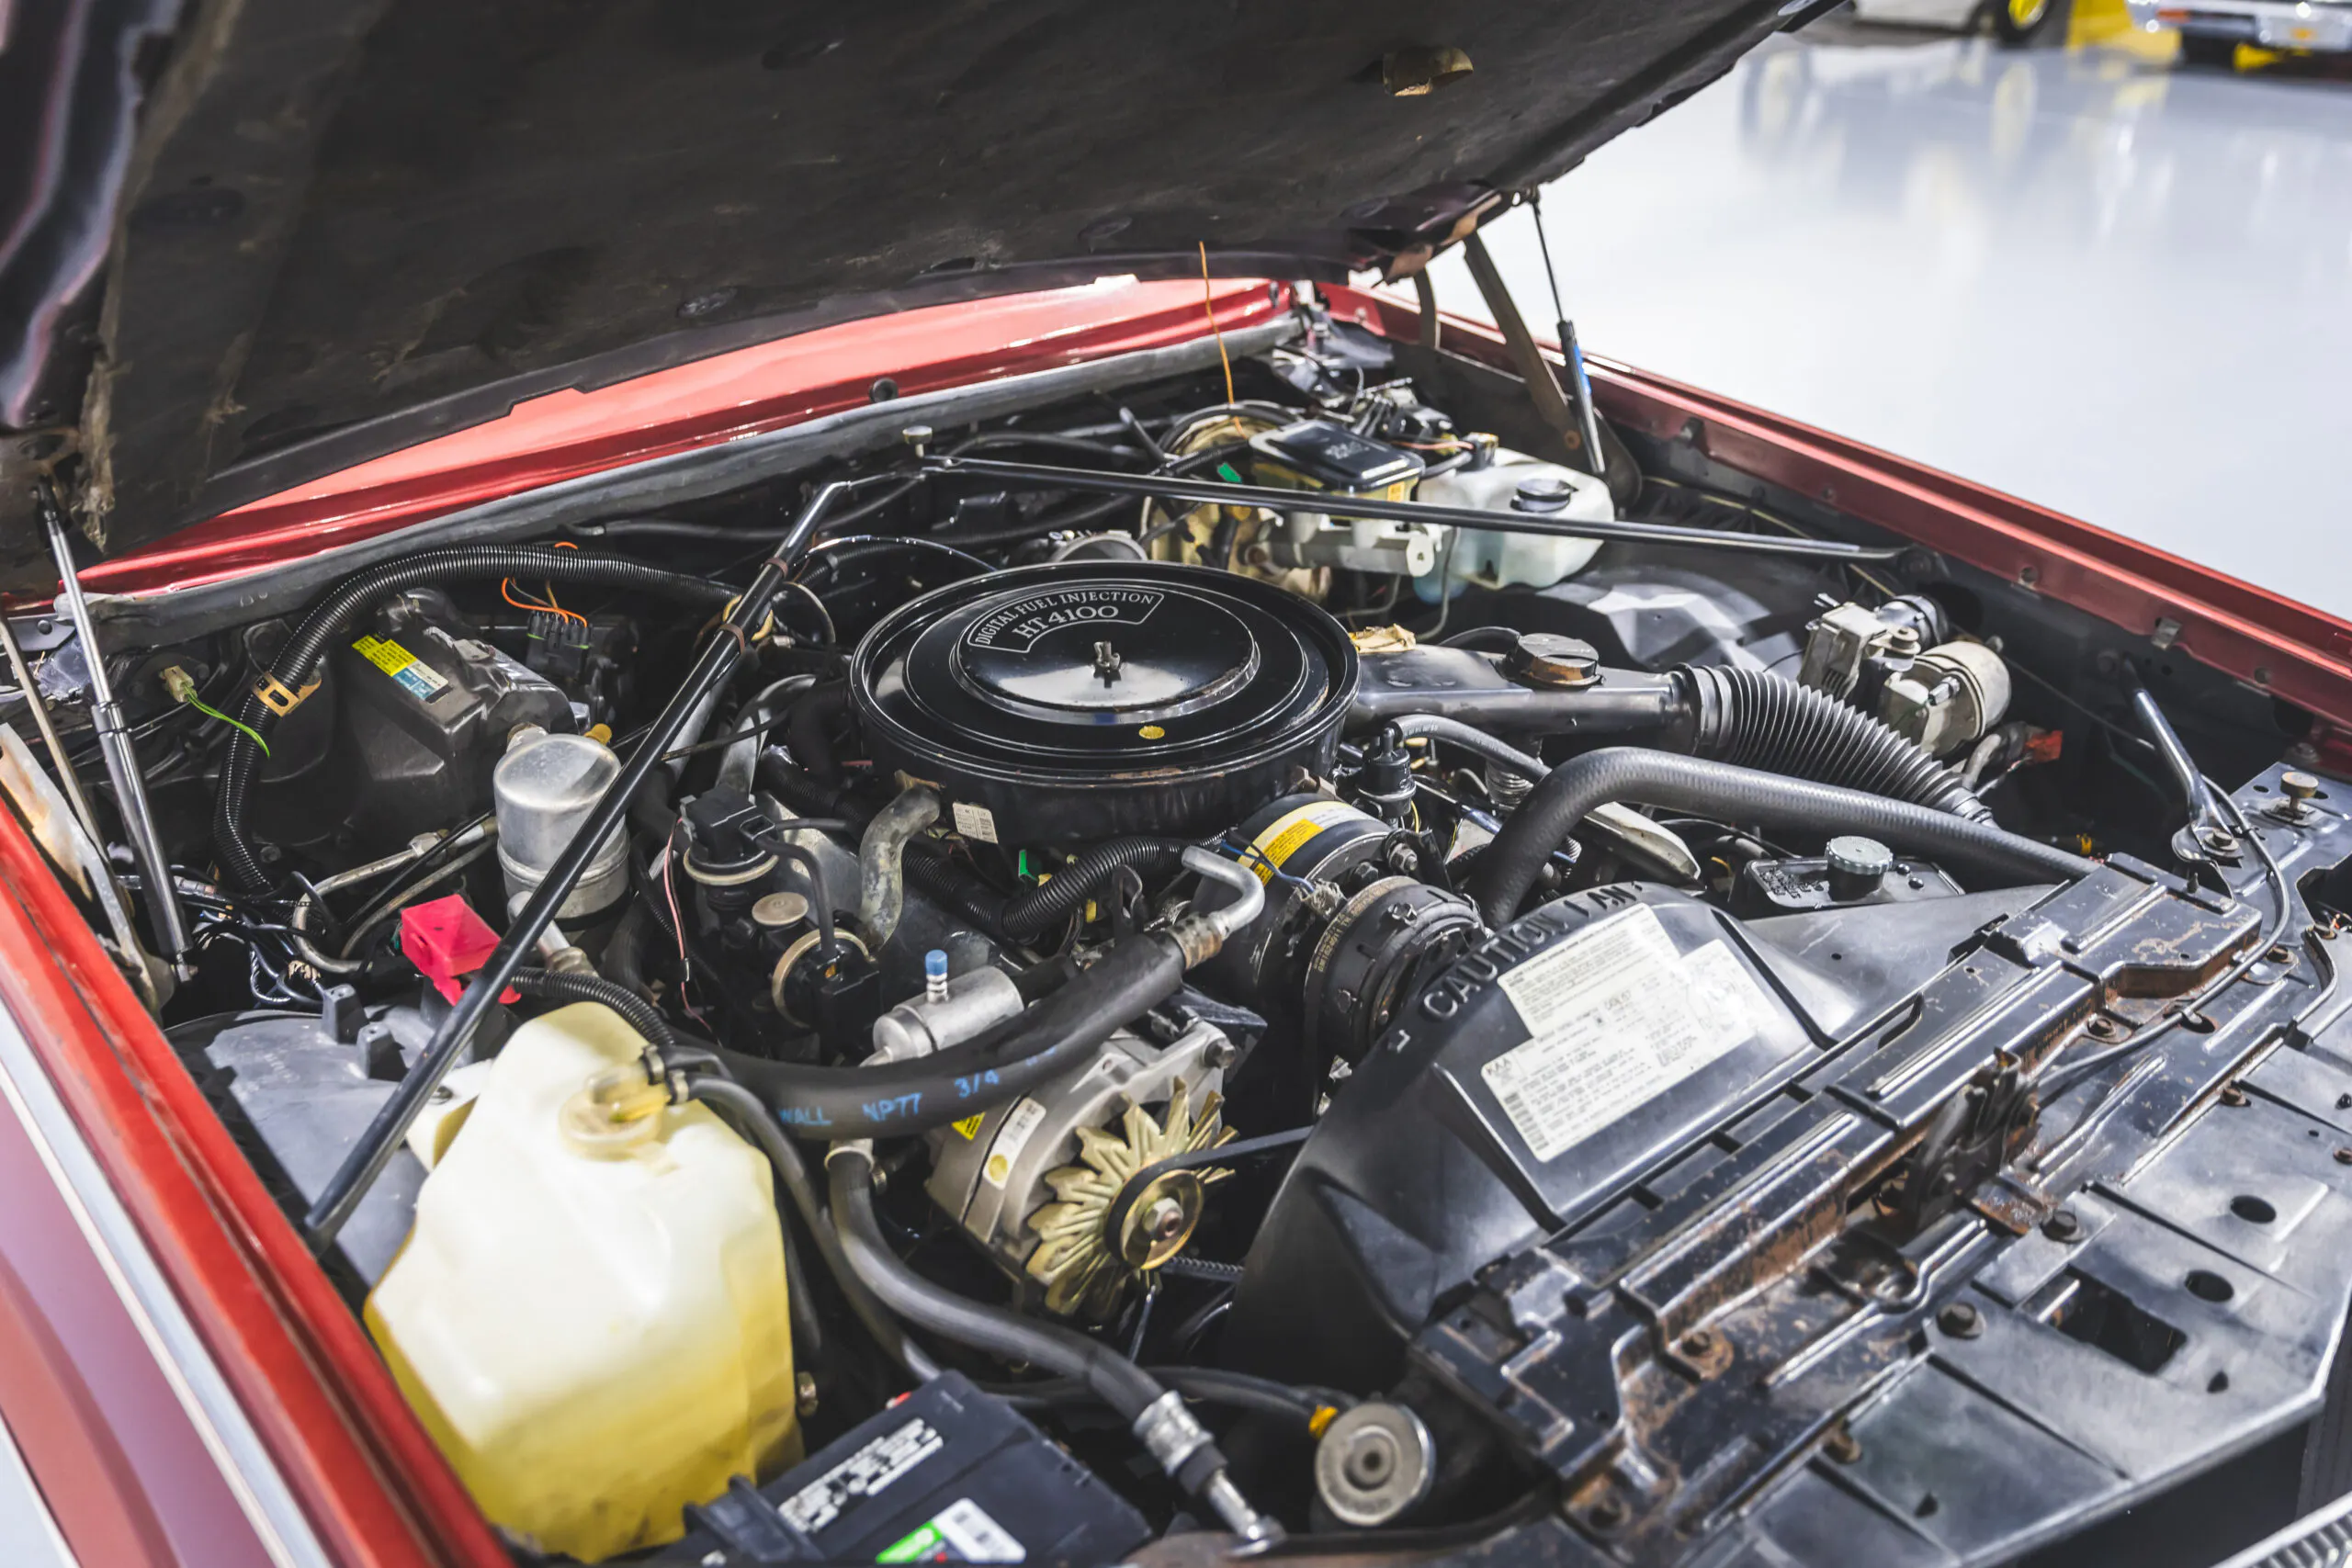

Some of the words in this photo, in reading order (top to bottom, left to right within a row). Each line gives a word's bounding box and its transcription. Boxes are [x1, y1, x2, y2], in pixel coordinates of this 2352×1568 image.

[975, 609, 1019, 646] DIGITAL
[1016, 597, 1057, 615] FUEL
[1059, 591, 1155, 604] INJECTION
[1012, 616, 1049, 639] HT
[1047, 605, 1119, 625] 4100
[1423, 913, 1569, 1019] CAUTION
[954, 1069, 1000, 1098] 3/4
